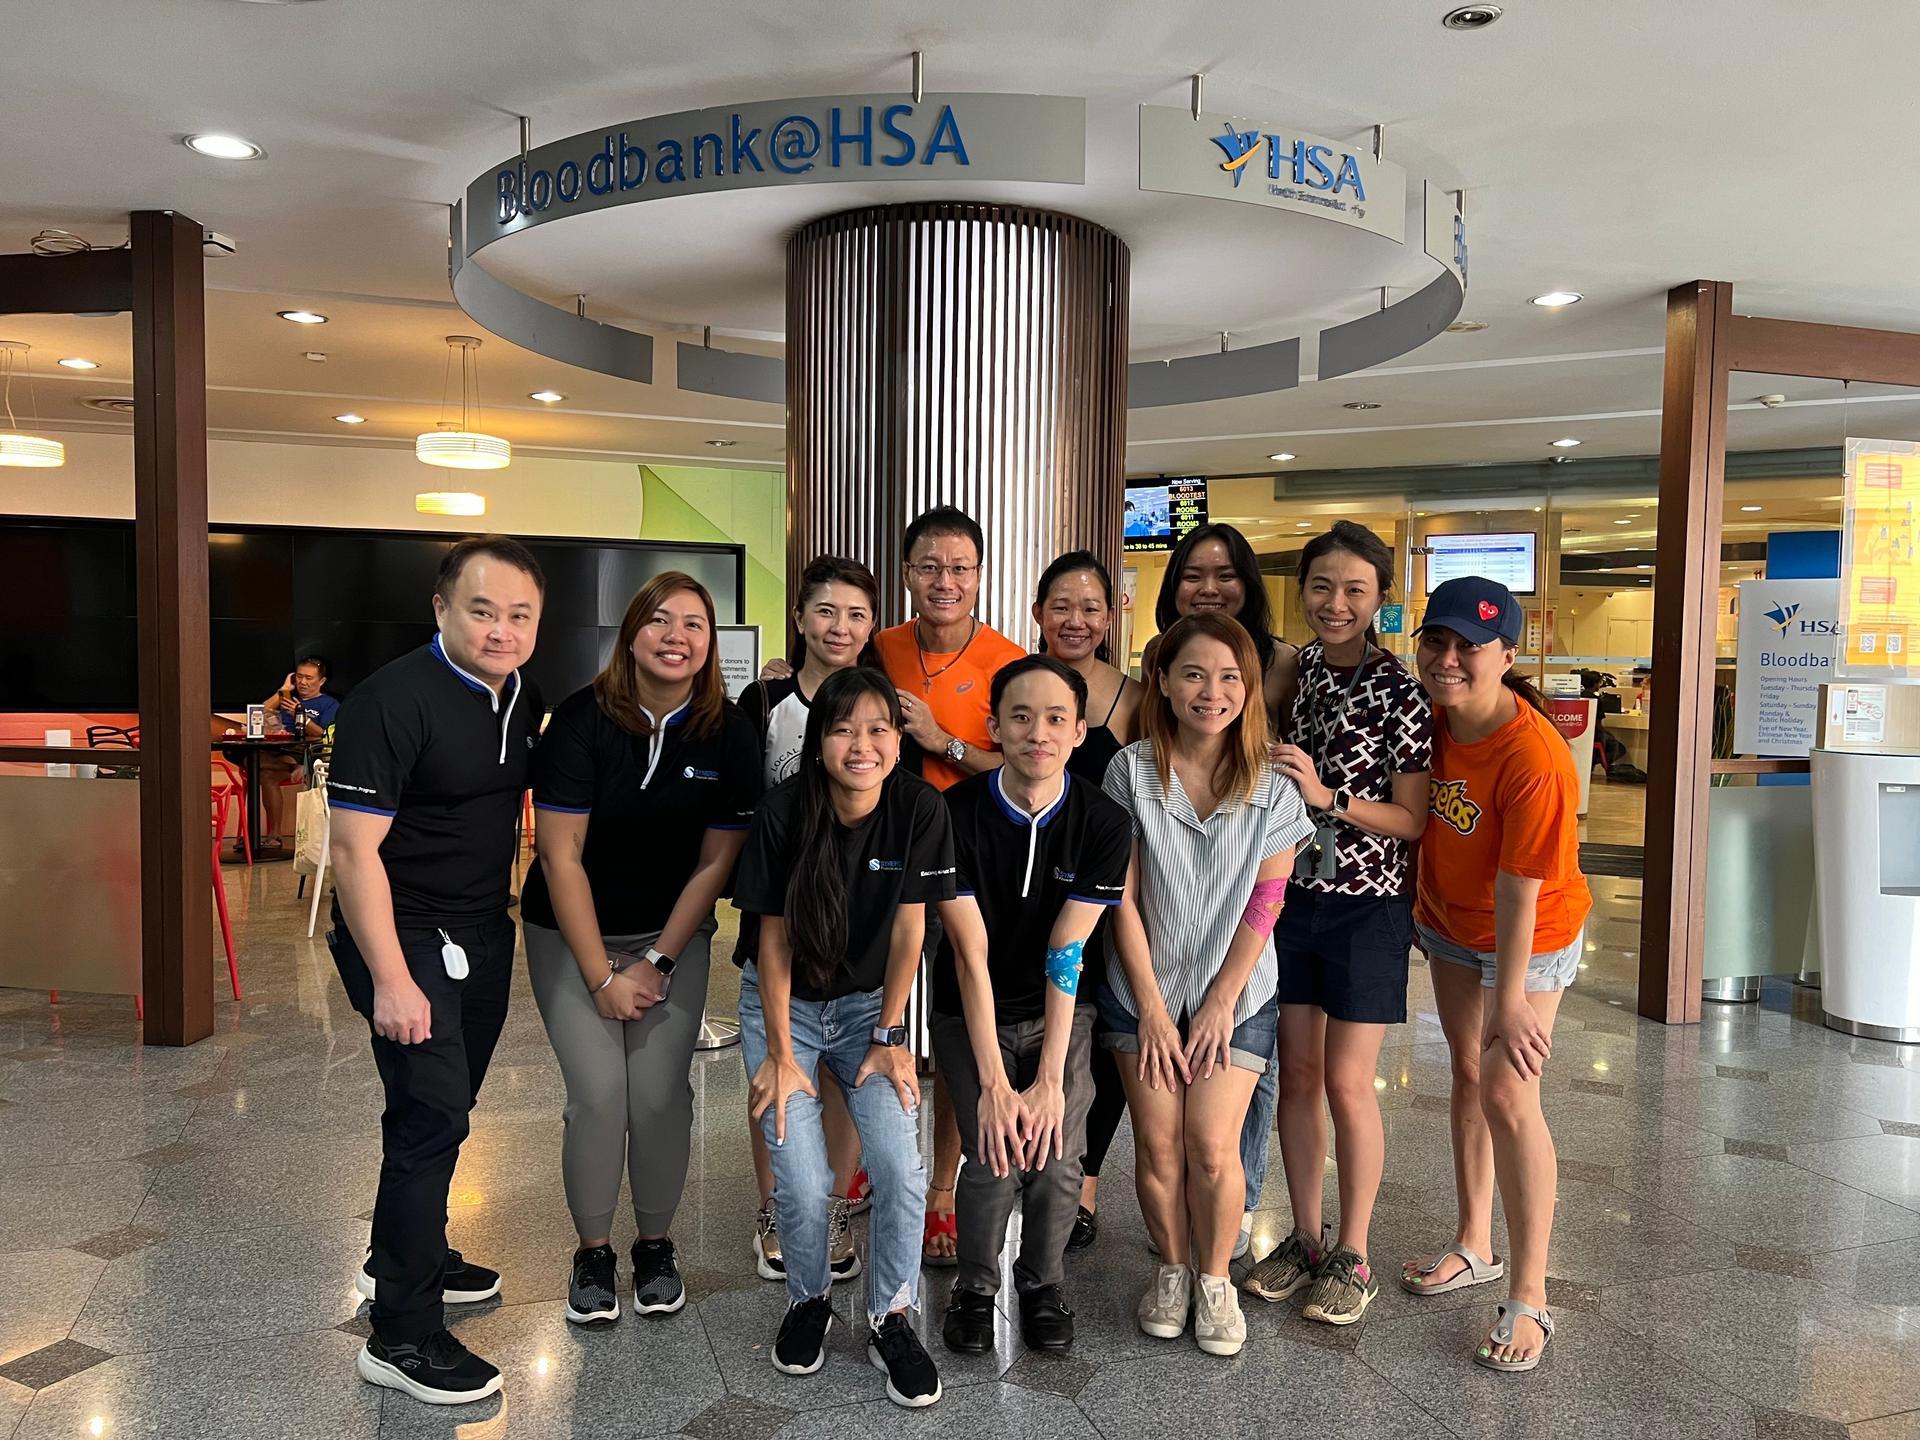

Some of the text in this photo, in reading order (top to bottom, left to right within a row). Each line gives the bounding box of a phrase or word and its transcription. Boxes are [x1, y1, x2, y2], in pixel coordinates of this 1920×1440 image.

[497, 103, 970, 224] Bloodbank@HSA
[1263, 134, 1366, 201] HSA
[1761, 652, 1833, 667] Bloodba
[1760, 675, 1787, 683] Opening
[1761, 684, 1785, 692] Tuesday
[1760, 701, 1787, 709] Saturday
[1549, 713, 1583, 722] LCOME
[1760, 710, 1783, 718] Monday
